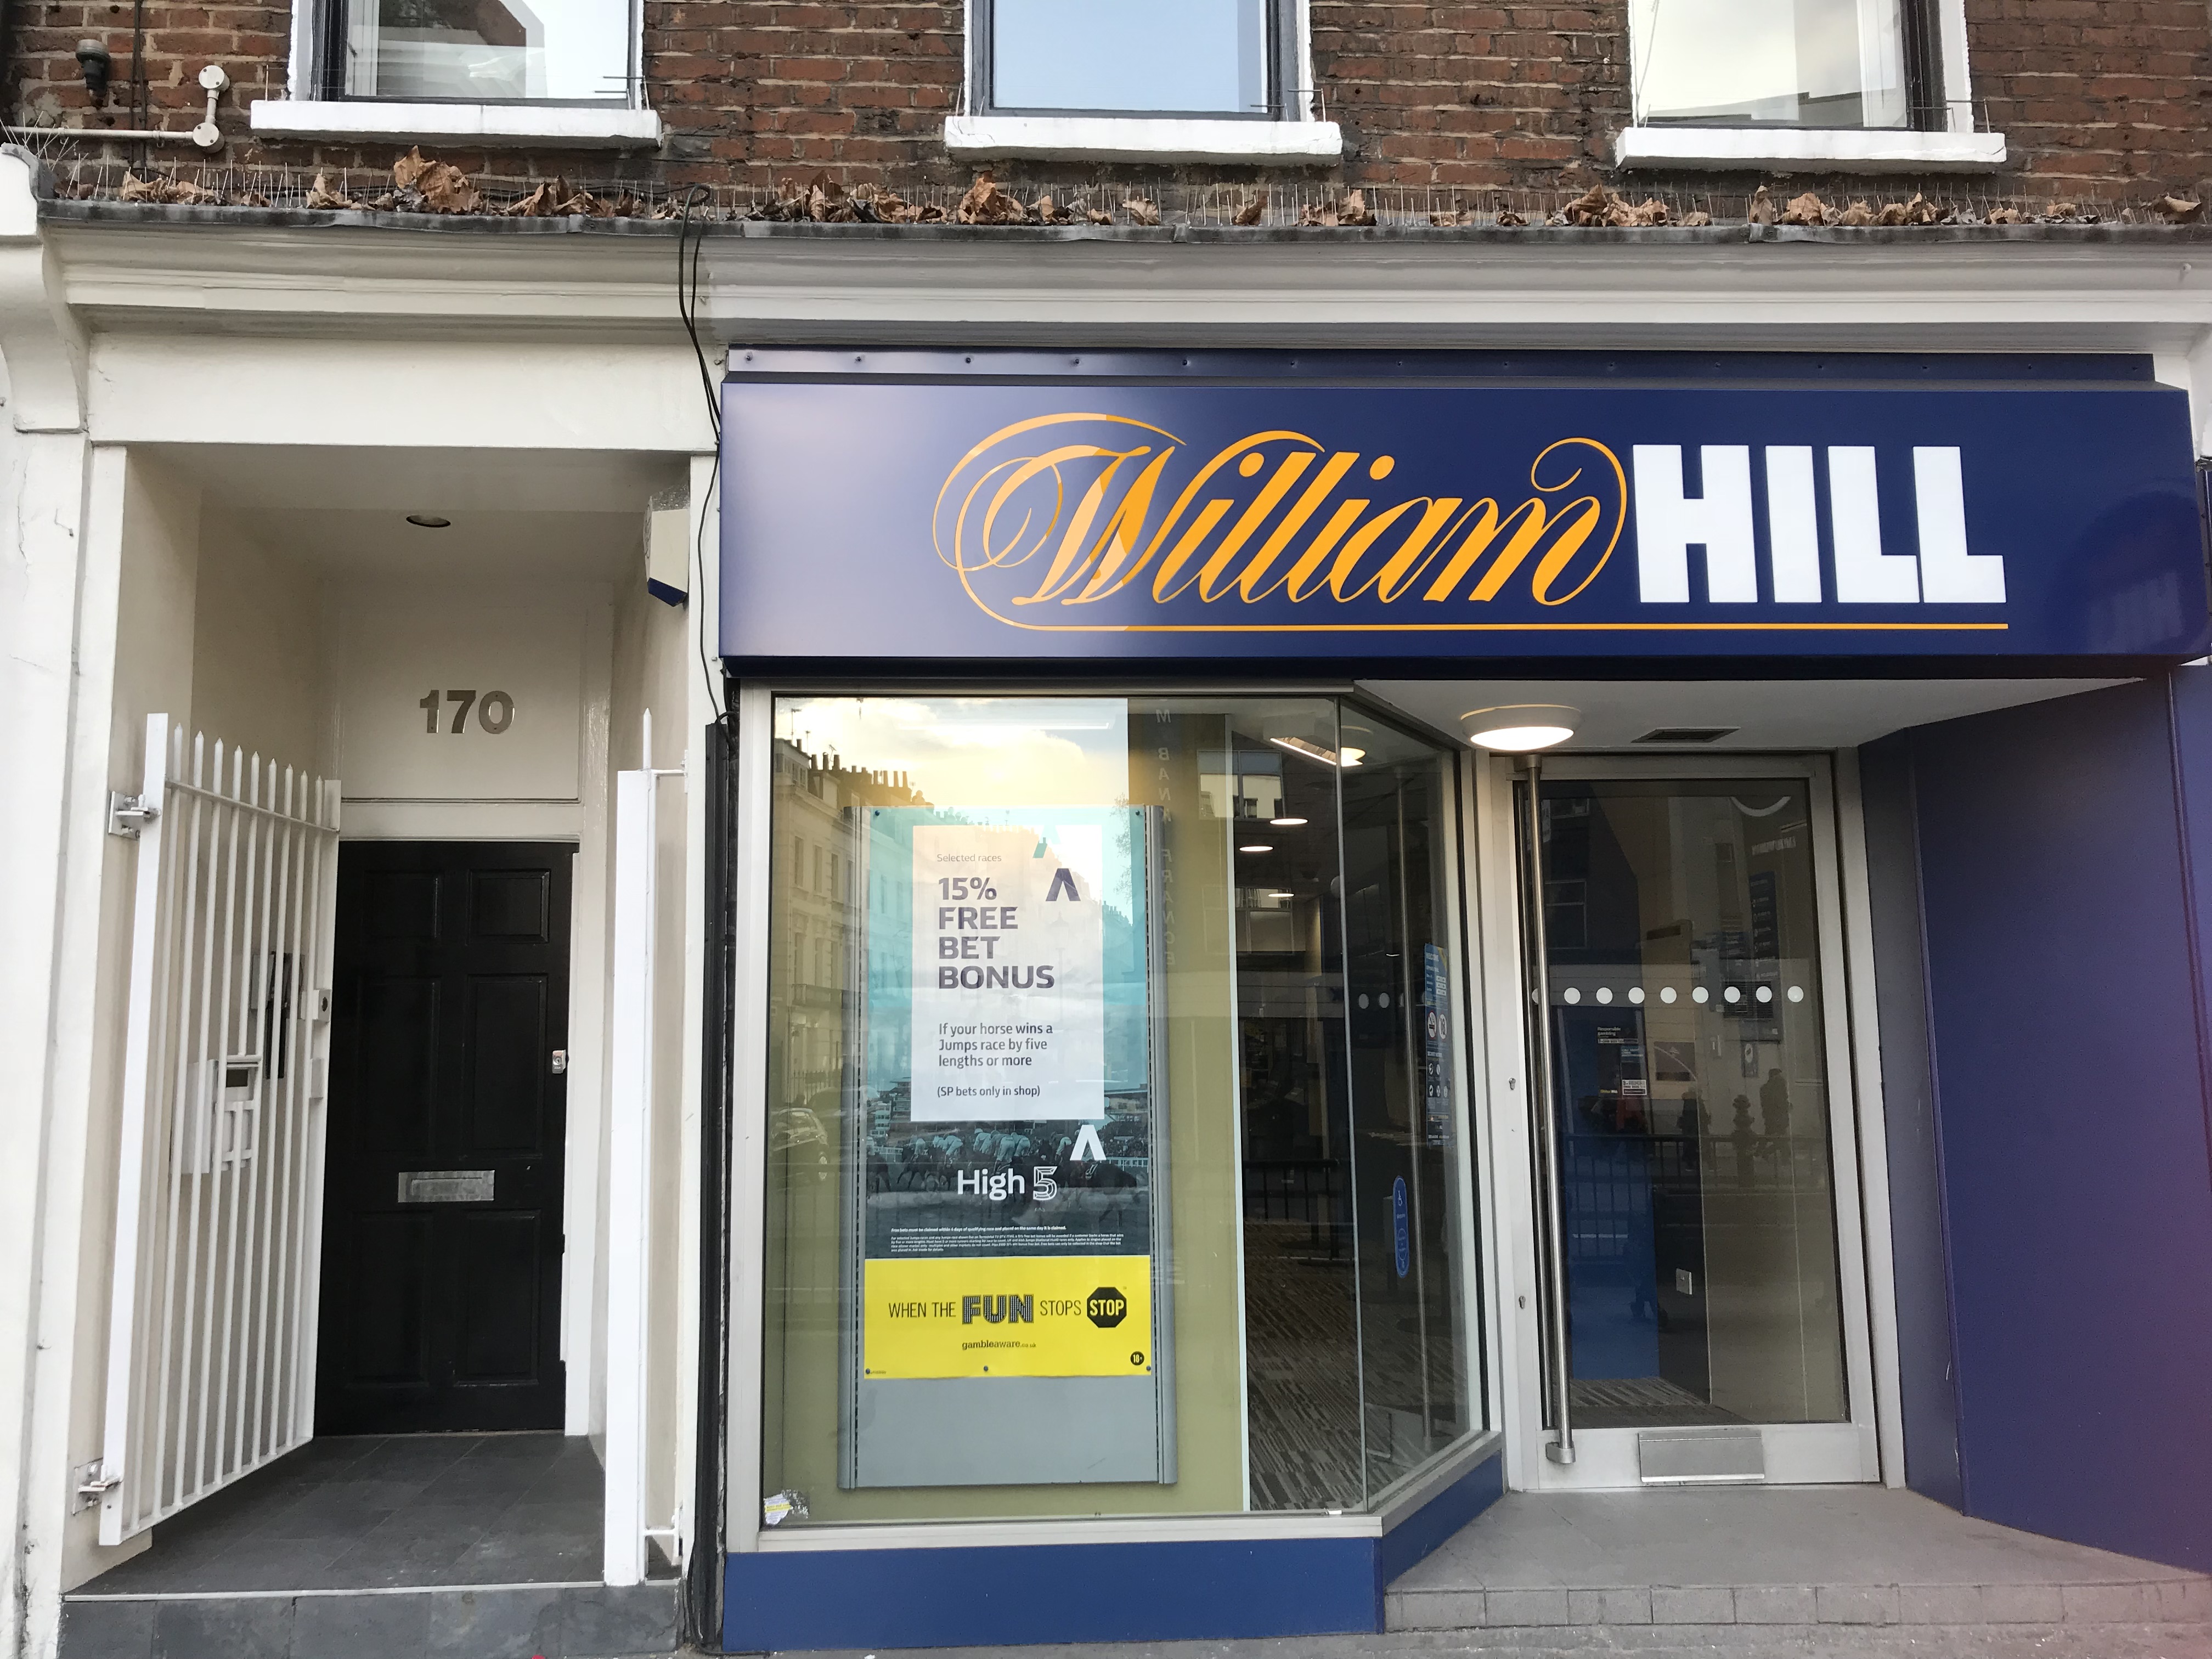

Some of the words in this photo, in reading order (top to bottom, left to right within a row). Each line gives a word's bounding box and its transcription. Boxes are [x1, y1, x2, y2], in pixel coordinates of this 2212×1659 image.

[933, 412, 1627, 607] William
[1633, 444, 2006, 603] HILL
[420, 689, 515, 734] 170
[937, 854, 975, 862] Selected
[939, 877, 997, 900] 15%
[939, 906, 1018, 929] FREE
[939, 936, 1001, 959] BET
[939, 965, 1054, 989] BONUS
[939, 1023, 948, 1035] If
[950, 1025, 977, 1037] your
[980, 1023, 1013, 1035] horse
[1015, 1022, 1043, 1034] wins
[1046, 1025, 1053, 1034] a
[939, 1039, 978, 1053] Jumps
[980, 1041, 1005, 1050] race
[1008, 1038, 1023, 1052] by
[1025, 1037, 1047, 1049] five
[939, 1054, 983, 1069] lengths
[986, 1057, 998, 1066] or
[1002, 1056, 1032, 1065] more
[937, 1086, 953, 1098] (SP
[956, 1086, 977, 1096] bets
[979, 1086, 1000, 1098] only
[1003, 1086, 1012, 1096] in
[1014, 1085, 1041, 1097] shop)
[957, 1168, 1025, 1200] High
[1033, 1166, 1058, 1200] 5
[888, 1302, 927, 1318] WHEN
[932, 1302, 956, 1317] THE
[962, 1294, 1034, 1324] FUN
[1040, 1300, 1081, 1316] STOPS
[1089, 1300, 1125, 1316] STOP
[962, 1339, 1037, 1350] gambleaware.co.uk
